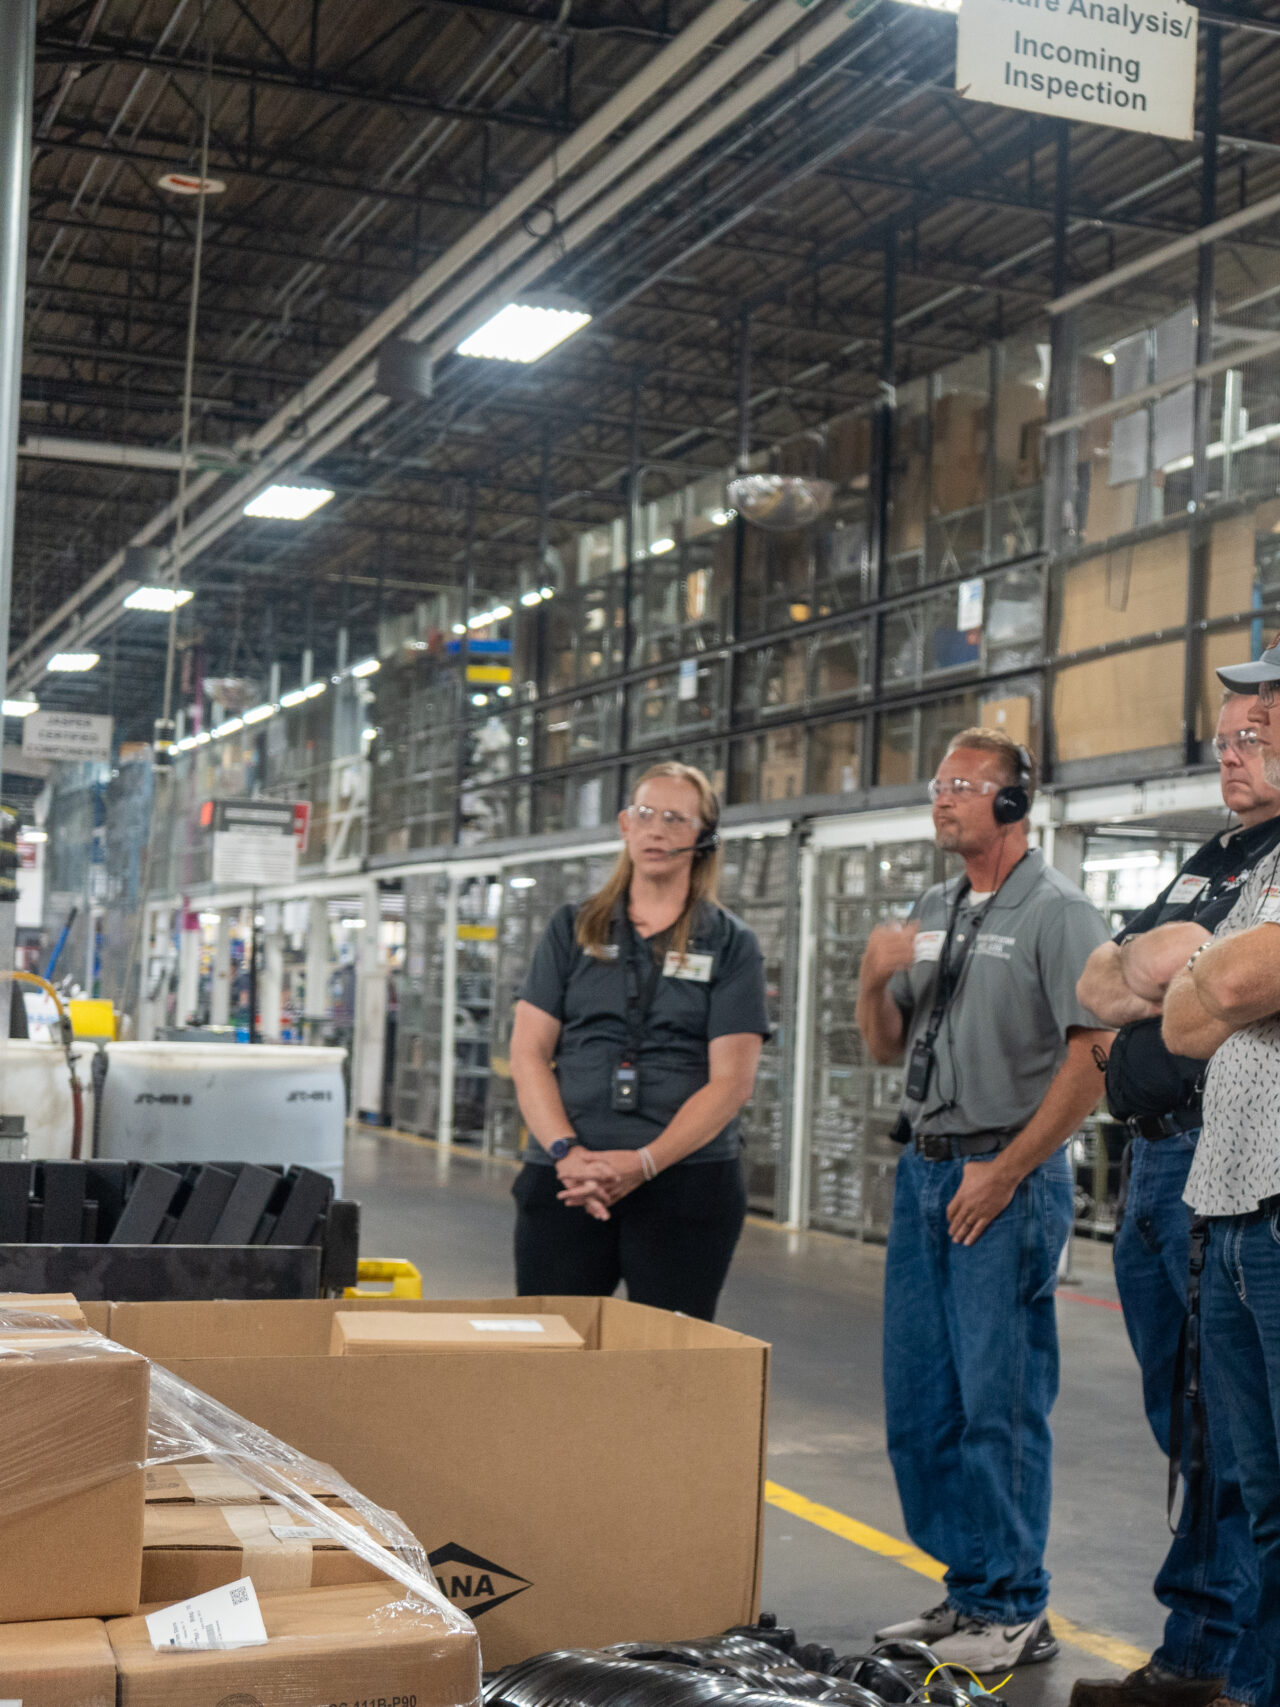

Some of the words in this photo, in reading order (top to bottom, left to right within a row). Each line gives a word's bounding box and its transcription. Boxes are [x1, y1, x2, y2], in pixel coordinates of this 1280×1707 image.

[1068, 0, 1193, 39] Analysis/
[1013, 30, 1141, 84] Incoming
[1004, 61, 1147, 112] Inspection
[434, 1573, 496, 1599] ANA
